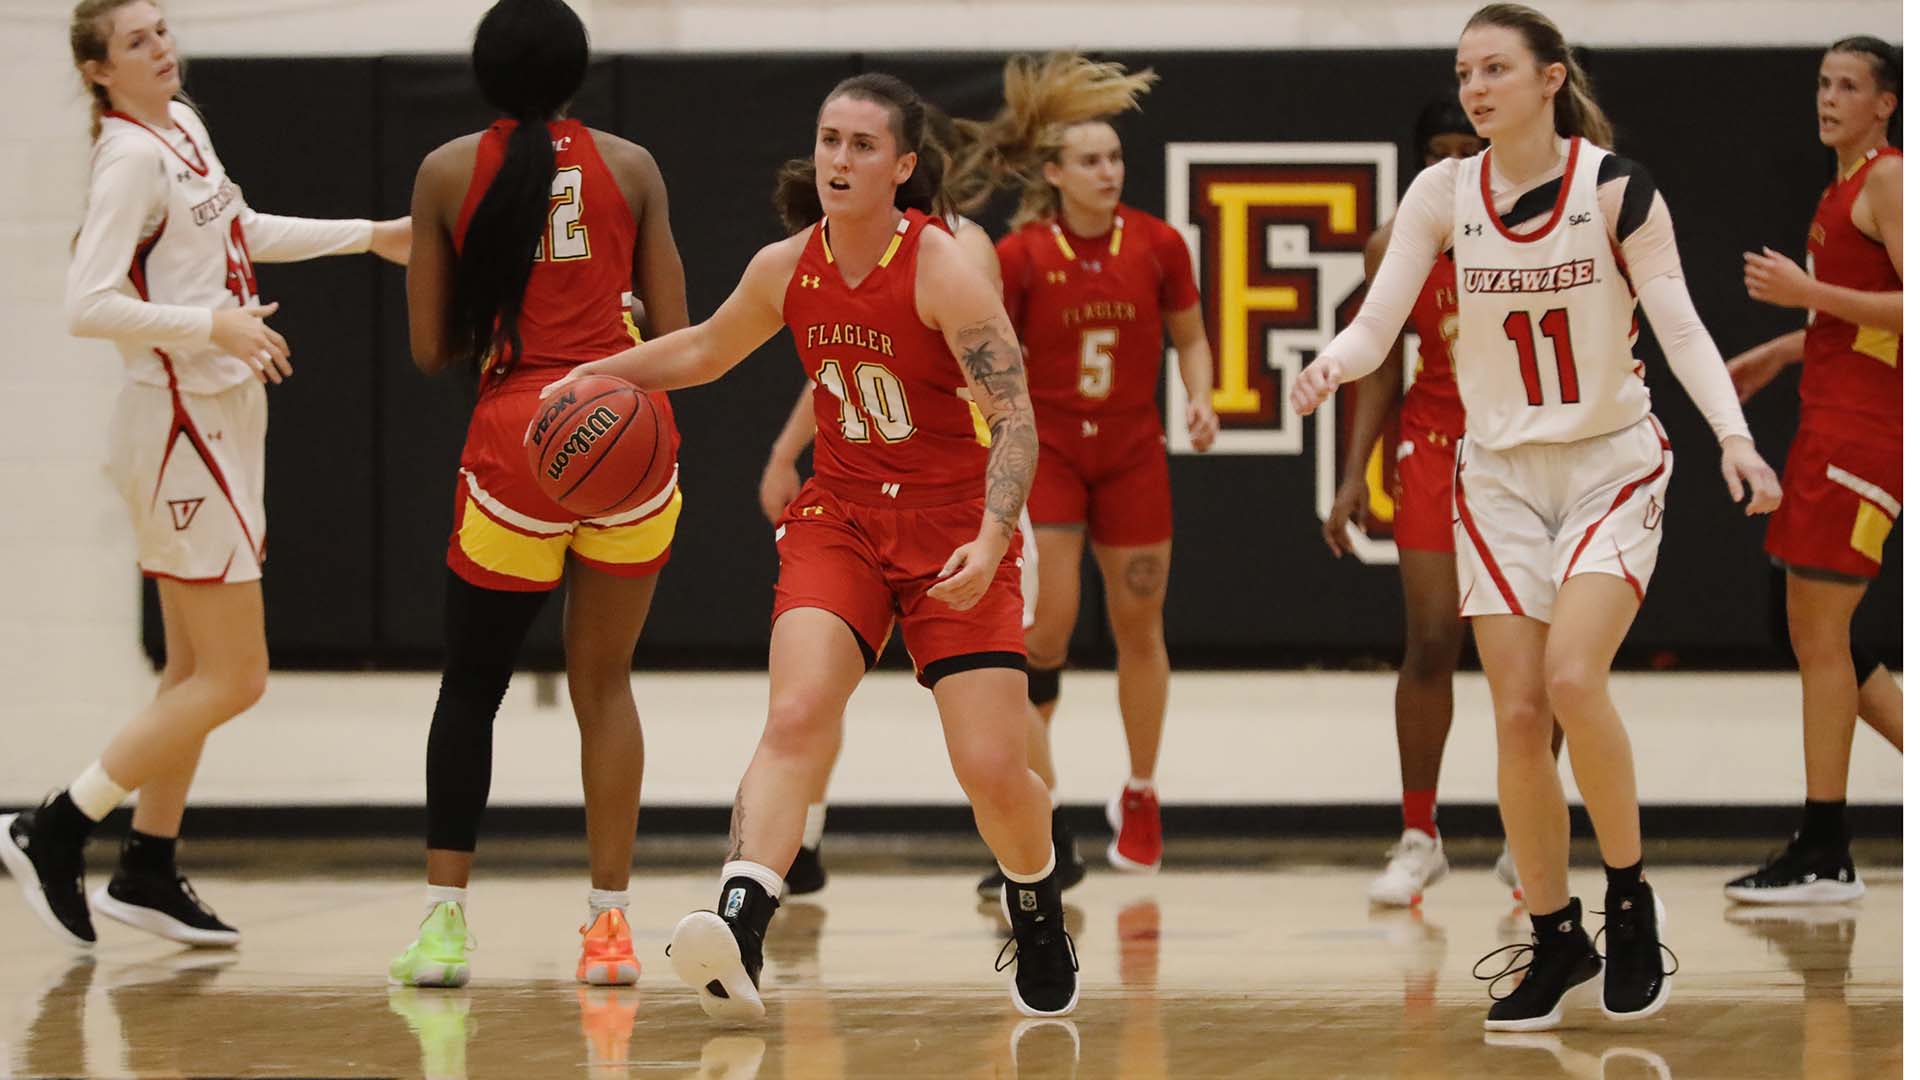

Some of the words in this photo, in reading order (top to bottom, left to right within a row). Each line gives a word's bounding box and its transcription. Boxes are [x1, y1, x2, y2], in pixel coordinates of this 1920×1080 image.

[533, 165, 591, 262] 2
[1568, 212, 1592, 226] SAC
[1199, 164, 1375, 430] F
[807, 323, 896, 357] FLAGLER
[1079, 327, 1119, 400] 5
[1503, 307, 1581, 406] 11
[533, 391, 577, 446] NCAA
[815, 359, 918, 444] 10
[547, 405, 622, 481] Wilson
